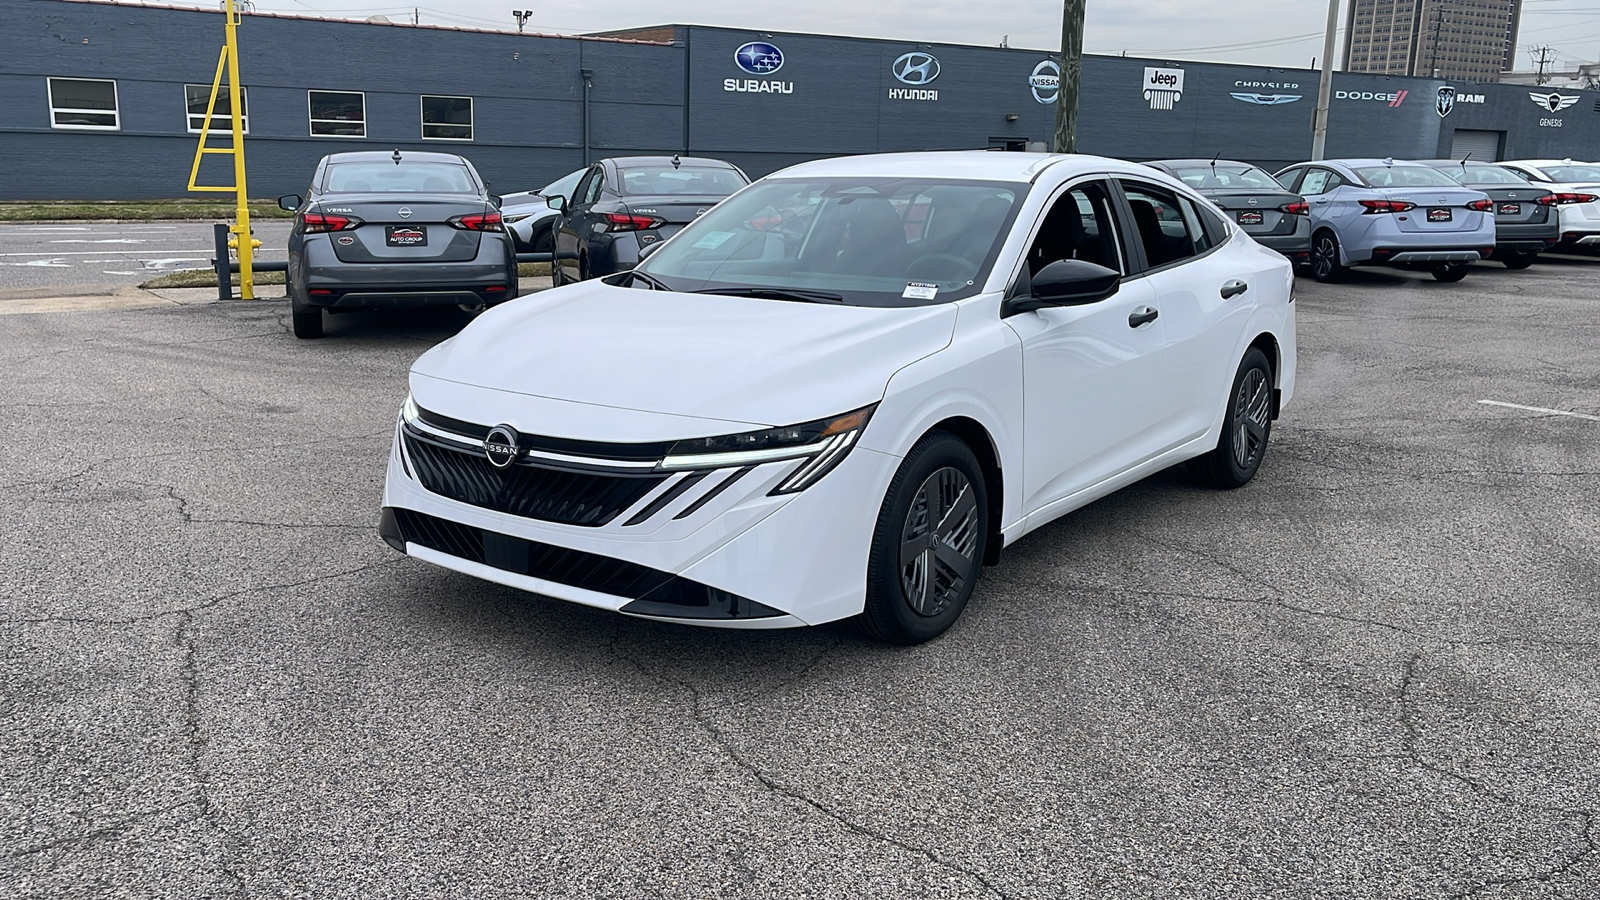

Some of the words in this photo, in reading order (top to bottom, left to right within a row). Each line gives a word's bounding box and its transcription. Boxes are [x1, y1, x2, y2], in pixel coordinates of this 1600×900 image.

[1150, 70, 1177, 88] Jeep
[1234, 80, 1299, 89] CHRYSLER
[723, 78, 794, 94] SUBARU
[889, 88, 938, 101] HYUNDAI
[1335, 90, 1398, 102] DODGE
[1456, 93, 1485, 104] RAM
[1539, 117, 1563, 127] GENESIS
[482, 442, 517, 455] NISSAN
